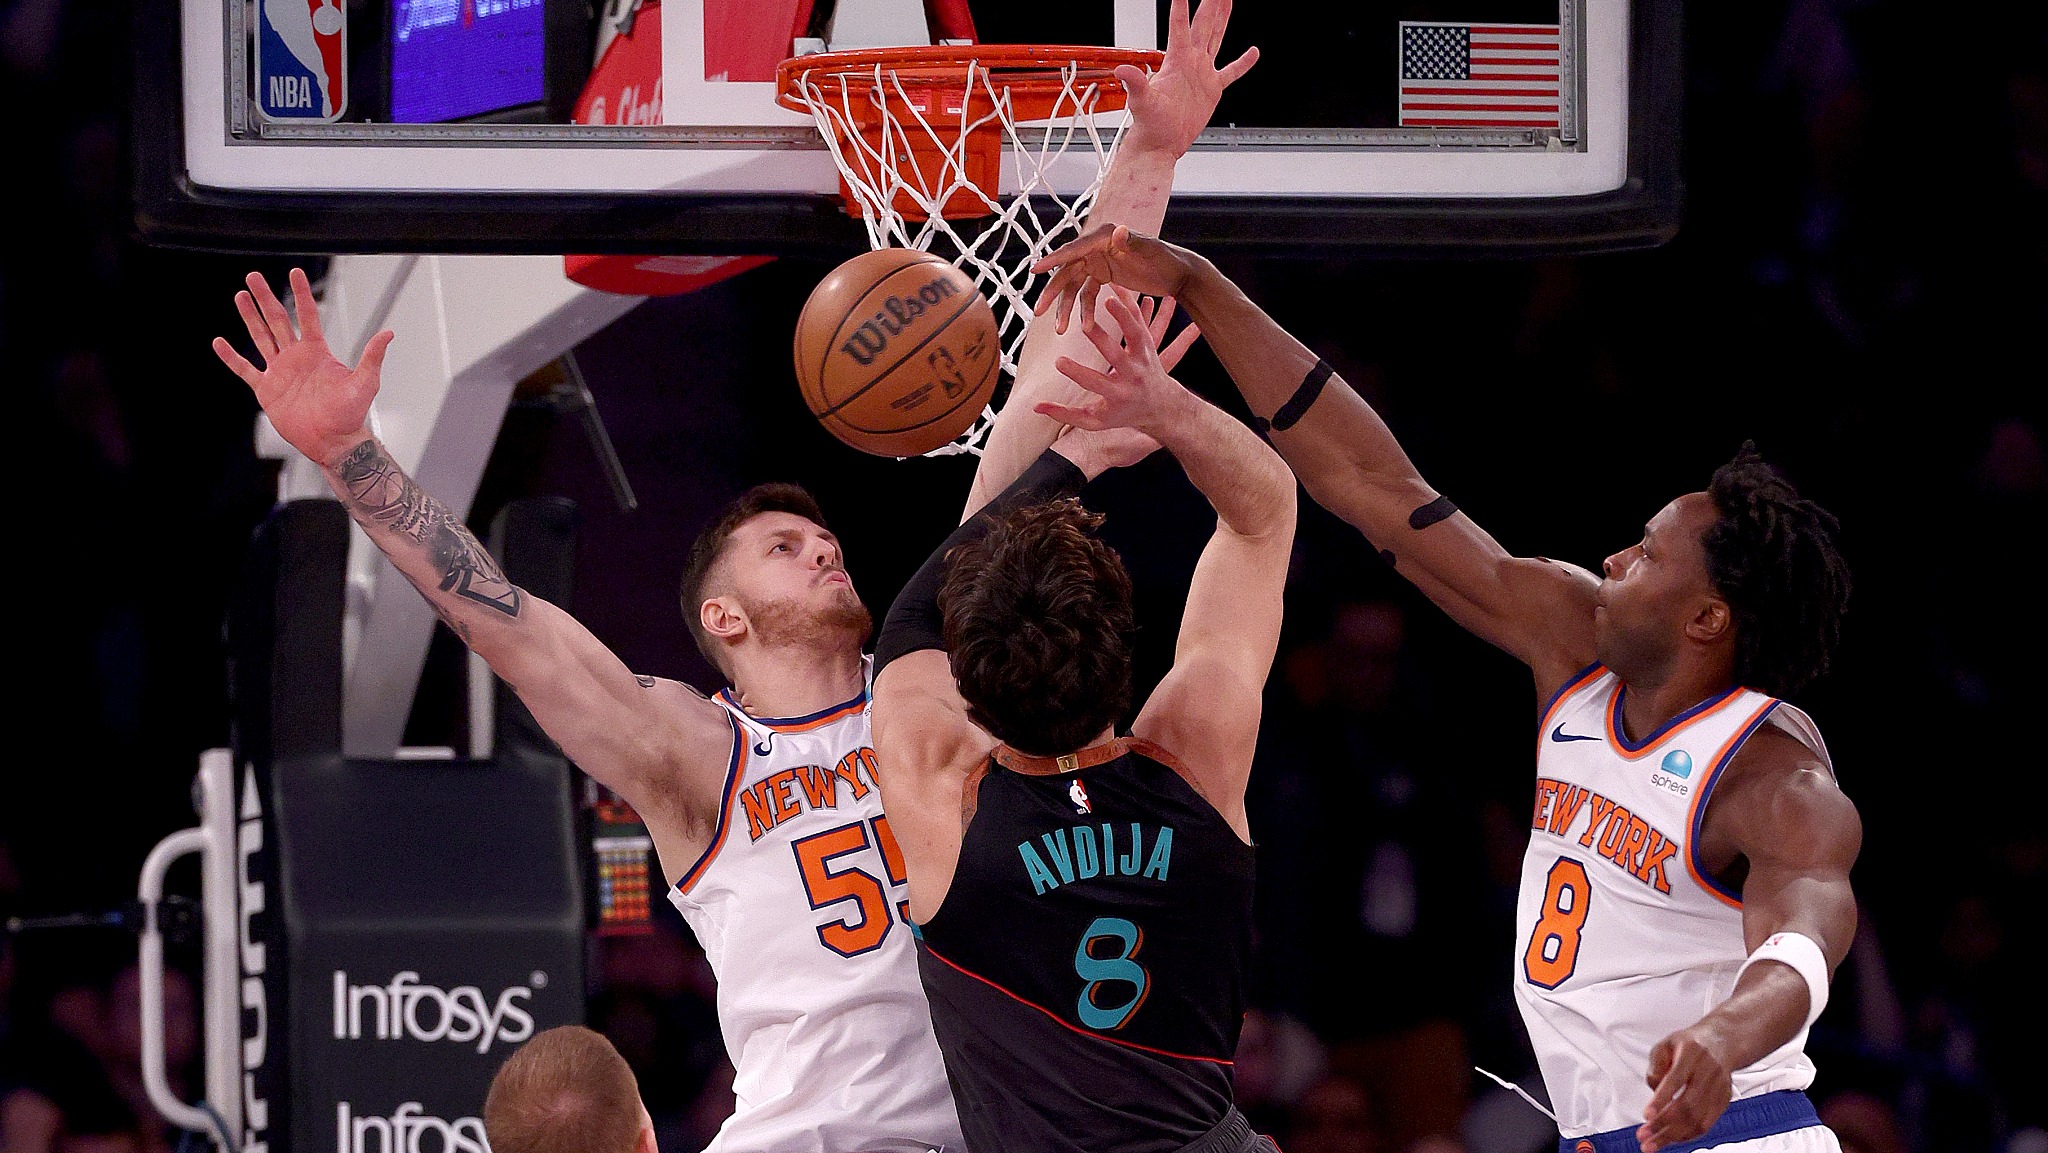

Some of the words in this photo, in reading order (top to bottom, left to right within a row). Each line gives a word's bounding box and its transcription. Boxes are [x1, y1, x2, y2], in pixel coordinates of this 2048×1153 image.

[270, 76, 312, 108] NBA
[841, 276, 961, 366] Wilson
[740, 765, 838, 843] NEW
[834, 746, 880, 802] YO
[1651, 774, 1688, 795] sphere
[1018, 822, 1174, 896] AVDIJA
[1578, 792, 1678, 896] YORK
[1524, 855, 1593, 990] 8
[333, 969, 535, 1055] Infosys
[1074, 917, 1151, 1031] 8
[337, 1101, 491, 1153] Infos
